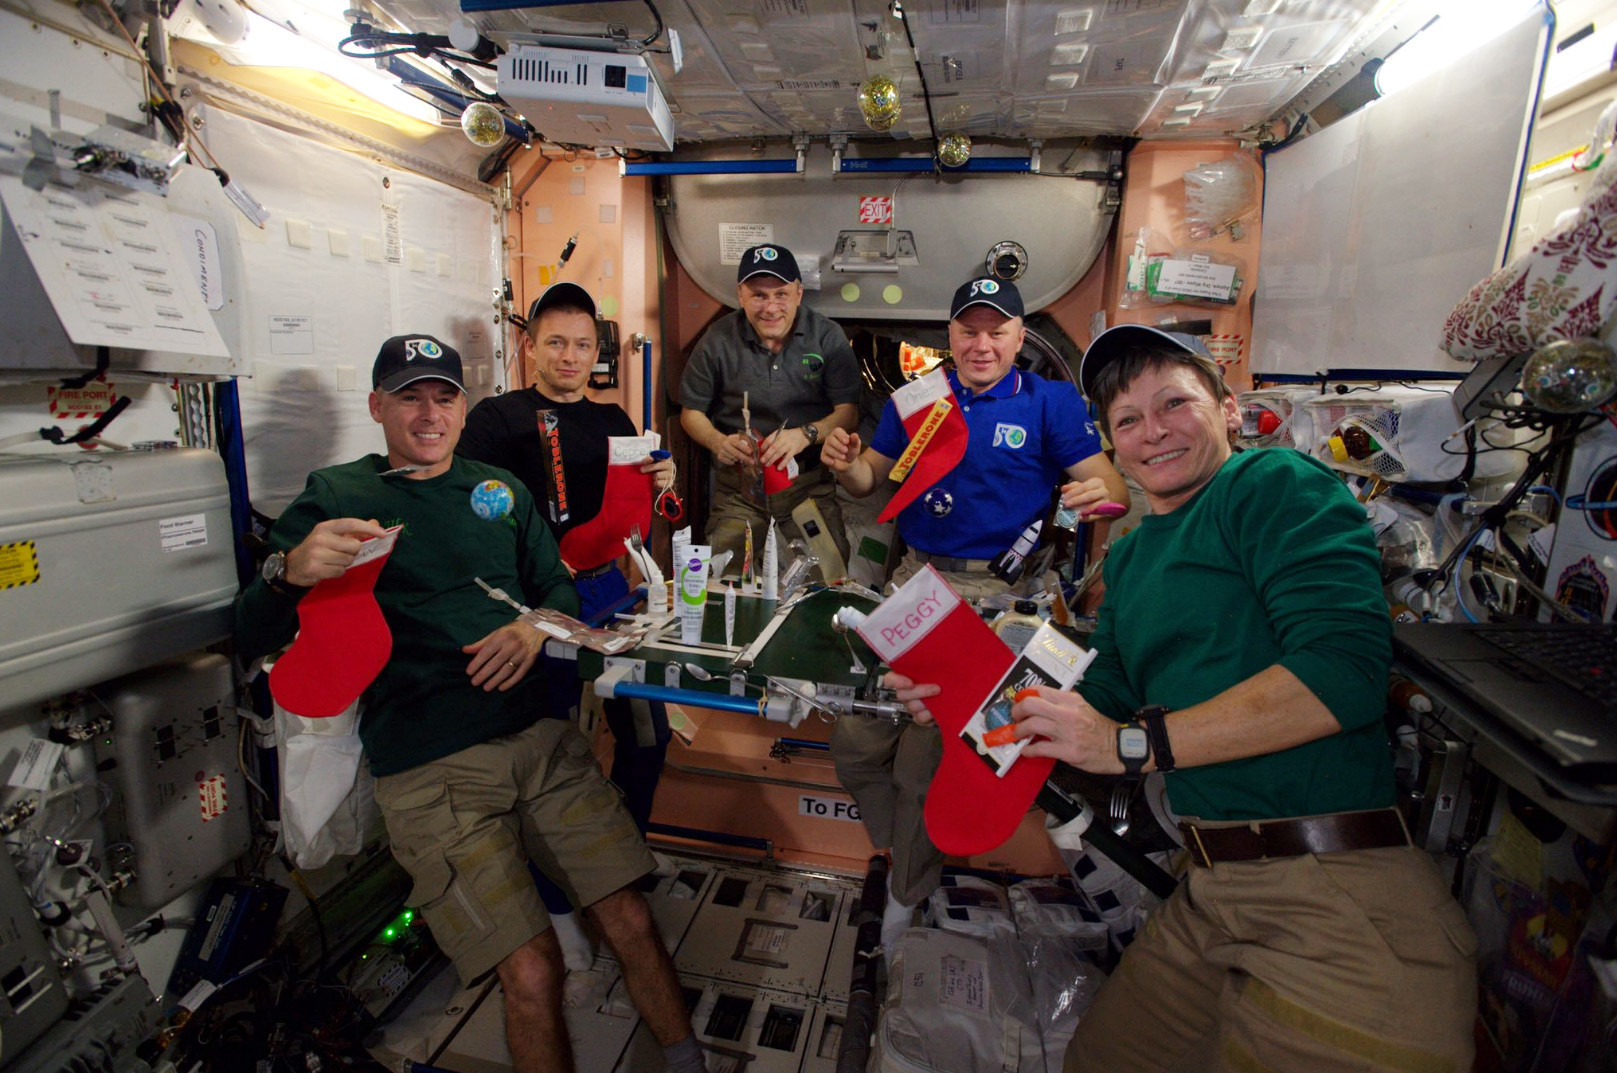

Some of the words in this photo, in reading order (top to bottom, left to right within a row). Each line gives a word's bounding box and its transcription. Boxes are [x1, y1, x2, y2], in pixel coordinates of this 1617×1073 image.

[864, 203, 886, 217] EXIT
[58, 391, 80, 399] FIRE
[83, 391, 107, 399] PORT
[898, 411, 944, 470] TOBLERONE
[548, 427, 567, 511] TOBLERONE
[880, 590, 941, 646] PEGGY
[803, 798, 827, 815] To
